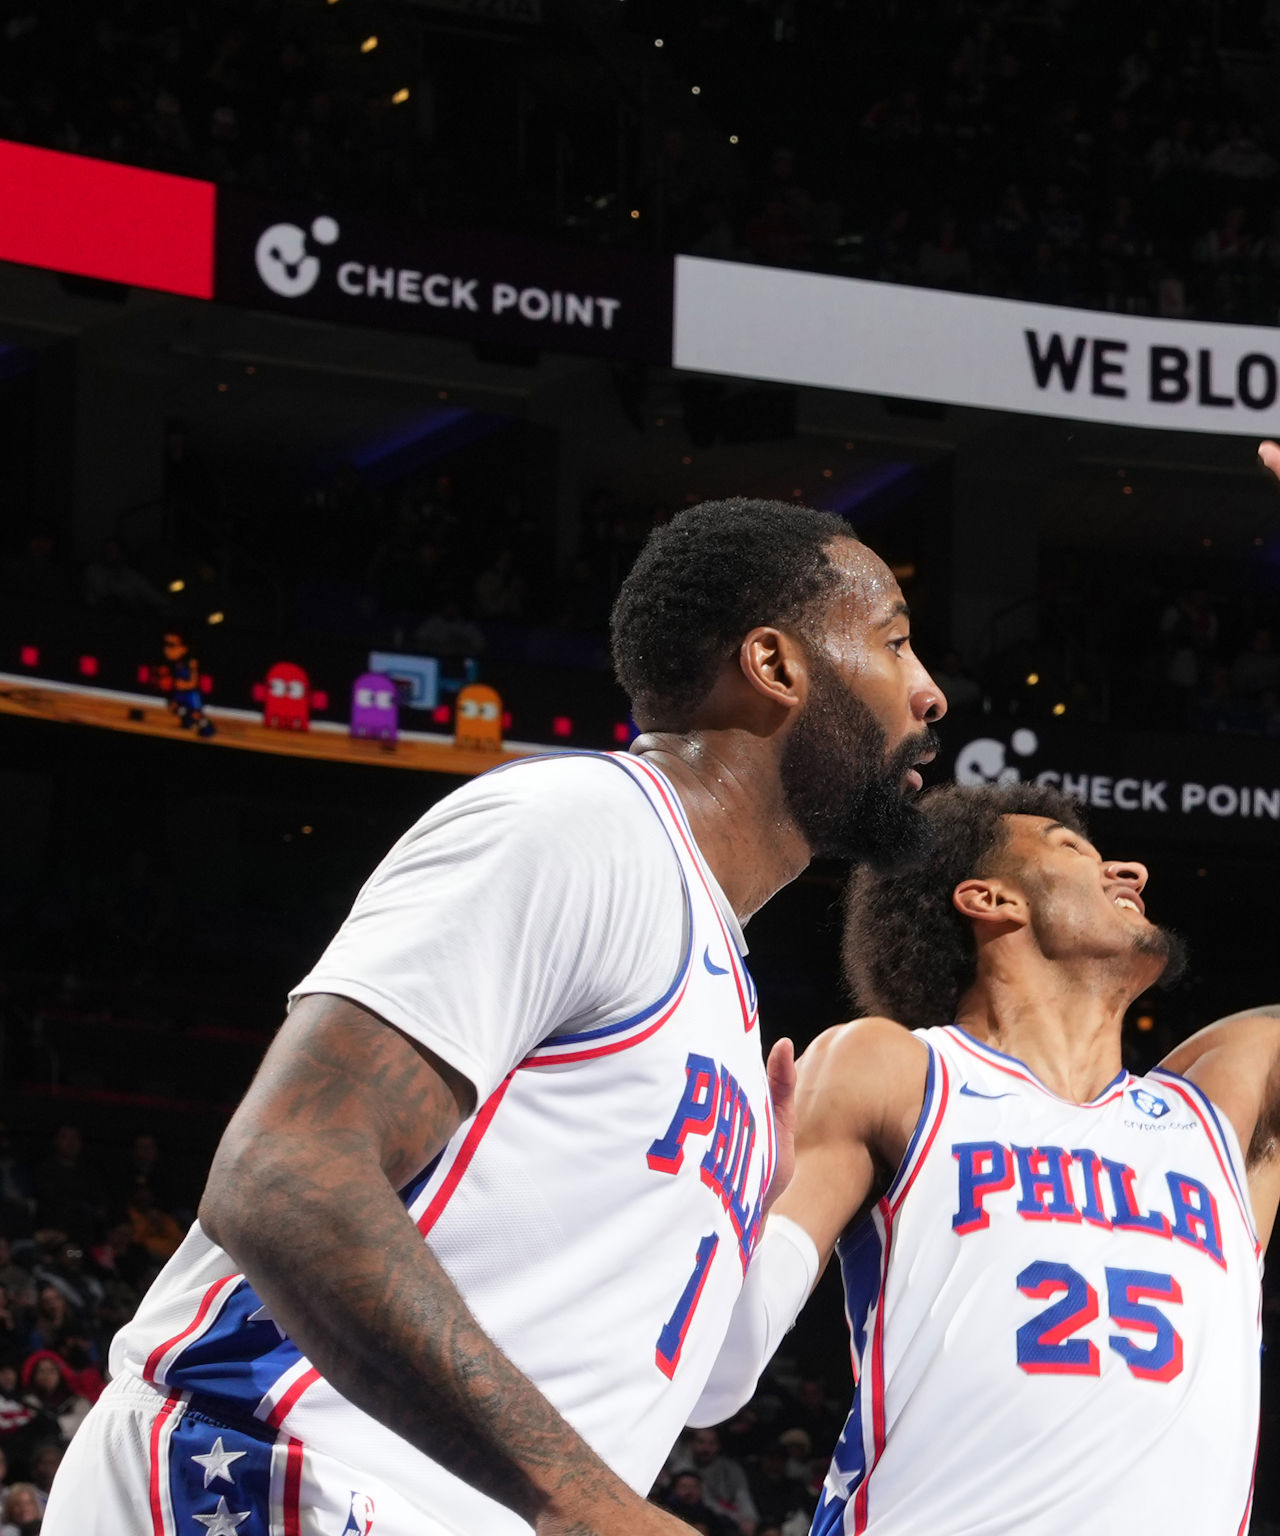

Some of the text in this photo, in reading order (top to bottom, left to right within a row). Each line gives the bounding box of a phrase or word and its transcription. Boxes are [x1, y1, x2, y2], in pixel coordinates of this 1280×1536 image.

[336, 260, 620, 331] CHECK POINT
[1024, 329, 1127, 398] WE
[1036, 769, 1168, 812] CHECK
[1123, 1118, 1198, 1132] crypto.com
[951, 1140, 1228, 1271] PHILA
[655, 1231, 720, 1381] 1
[1016, 1259, 1184, 1384] 25
